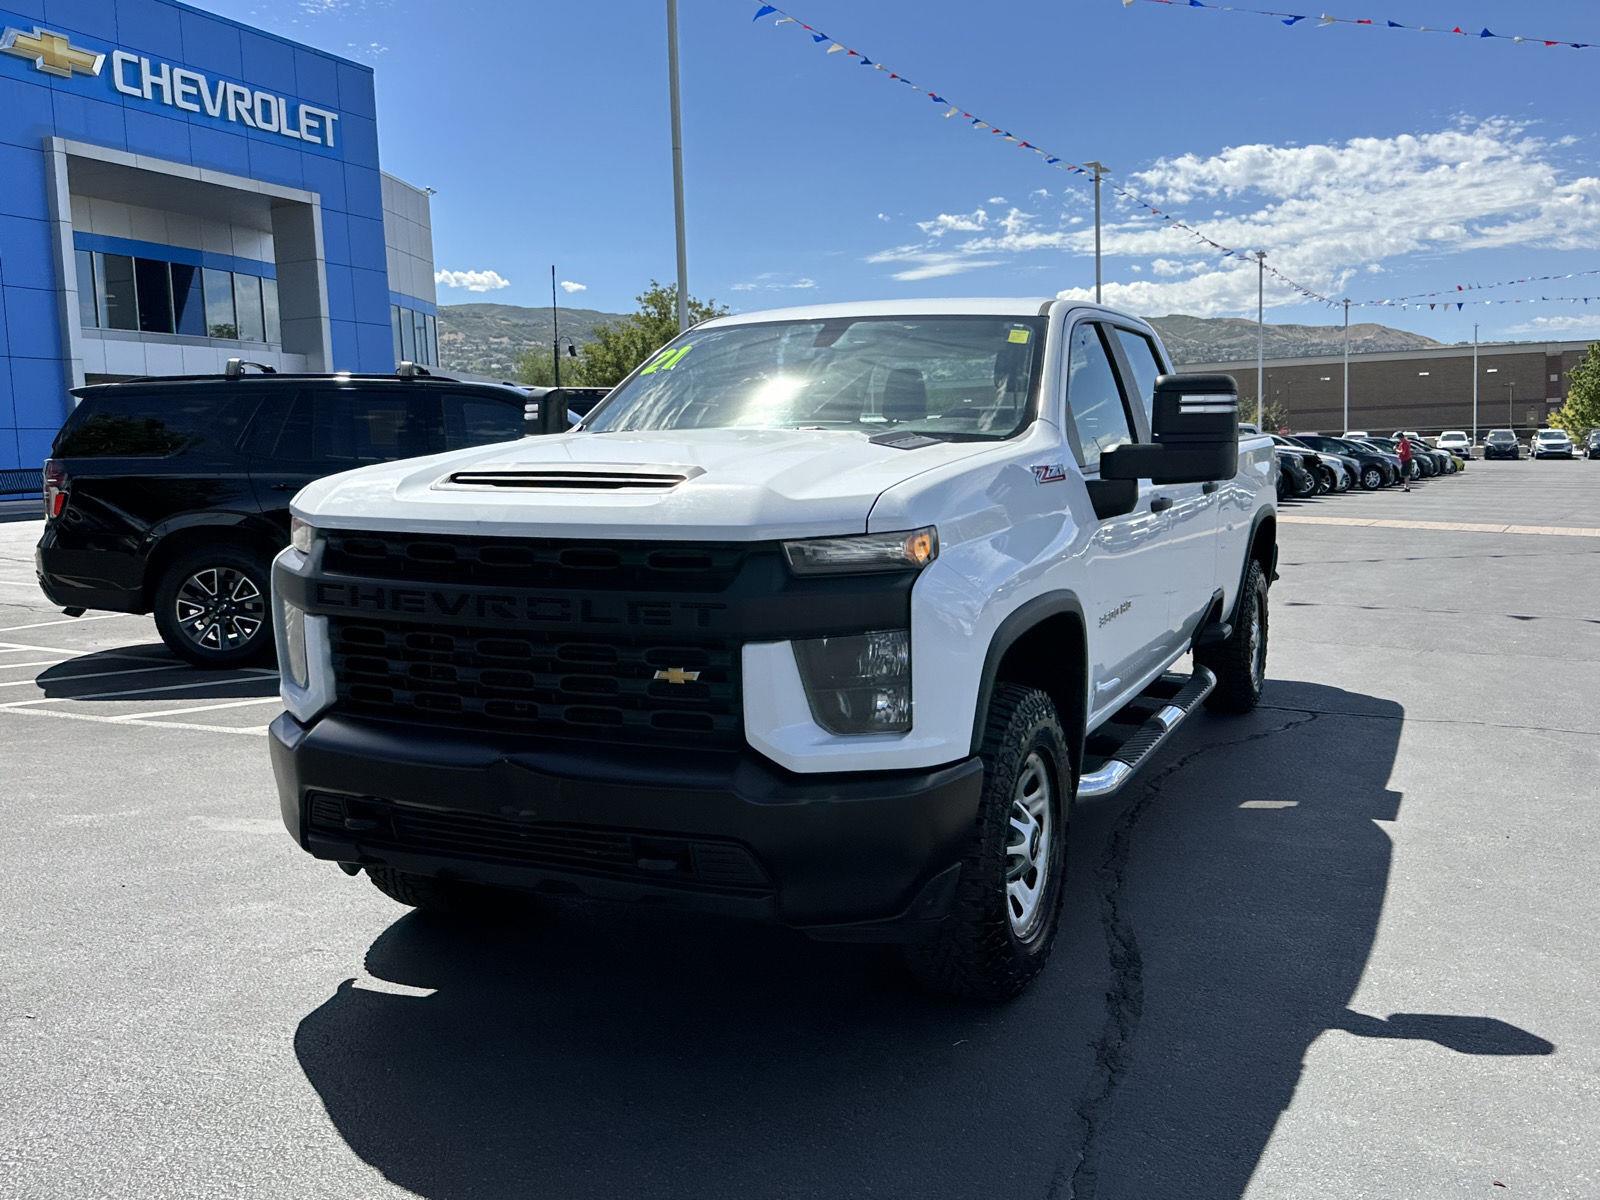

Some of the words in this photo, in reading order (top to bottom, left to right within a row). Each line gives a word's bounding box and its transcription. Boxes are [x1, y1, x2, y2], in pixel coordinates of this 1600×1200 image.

[111, 49, 339, 148] CHEVROLET
[639, 344, 694, 376] 21
[316, 582, 728, 627] CHEVROLET
